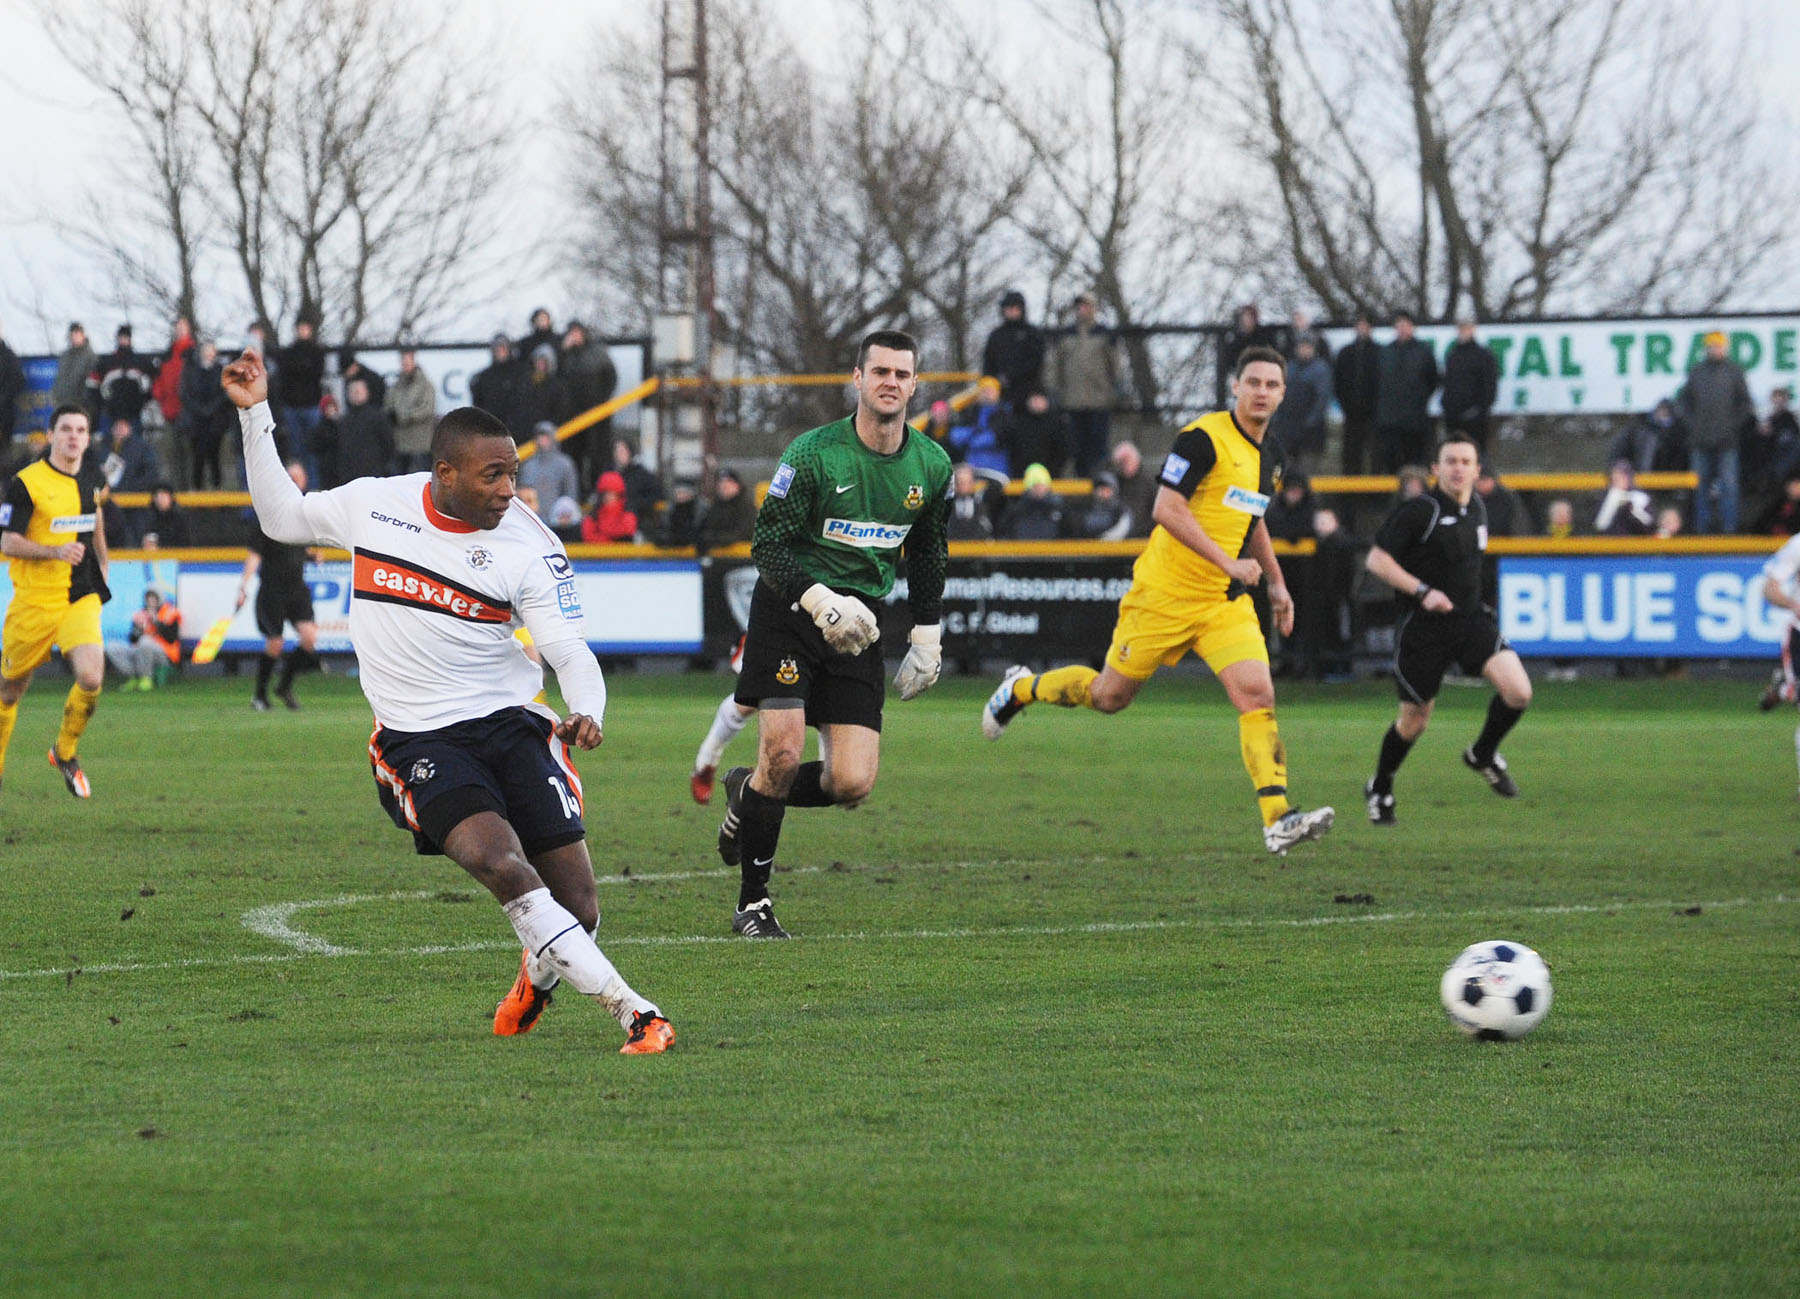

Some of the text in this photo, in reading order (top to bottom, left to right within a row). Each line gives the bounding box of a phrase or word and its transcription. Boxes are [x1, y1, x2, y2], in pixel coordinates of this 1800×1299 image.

[370, 511, 422, 534] carbrini
[372, 568, 484, 617] easyJet
[1500, 572, 1677, 642] BLUE
